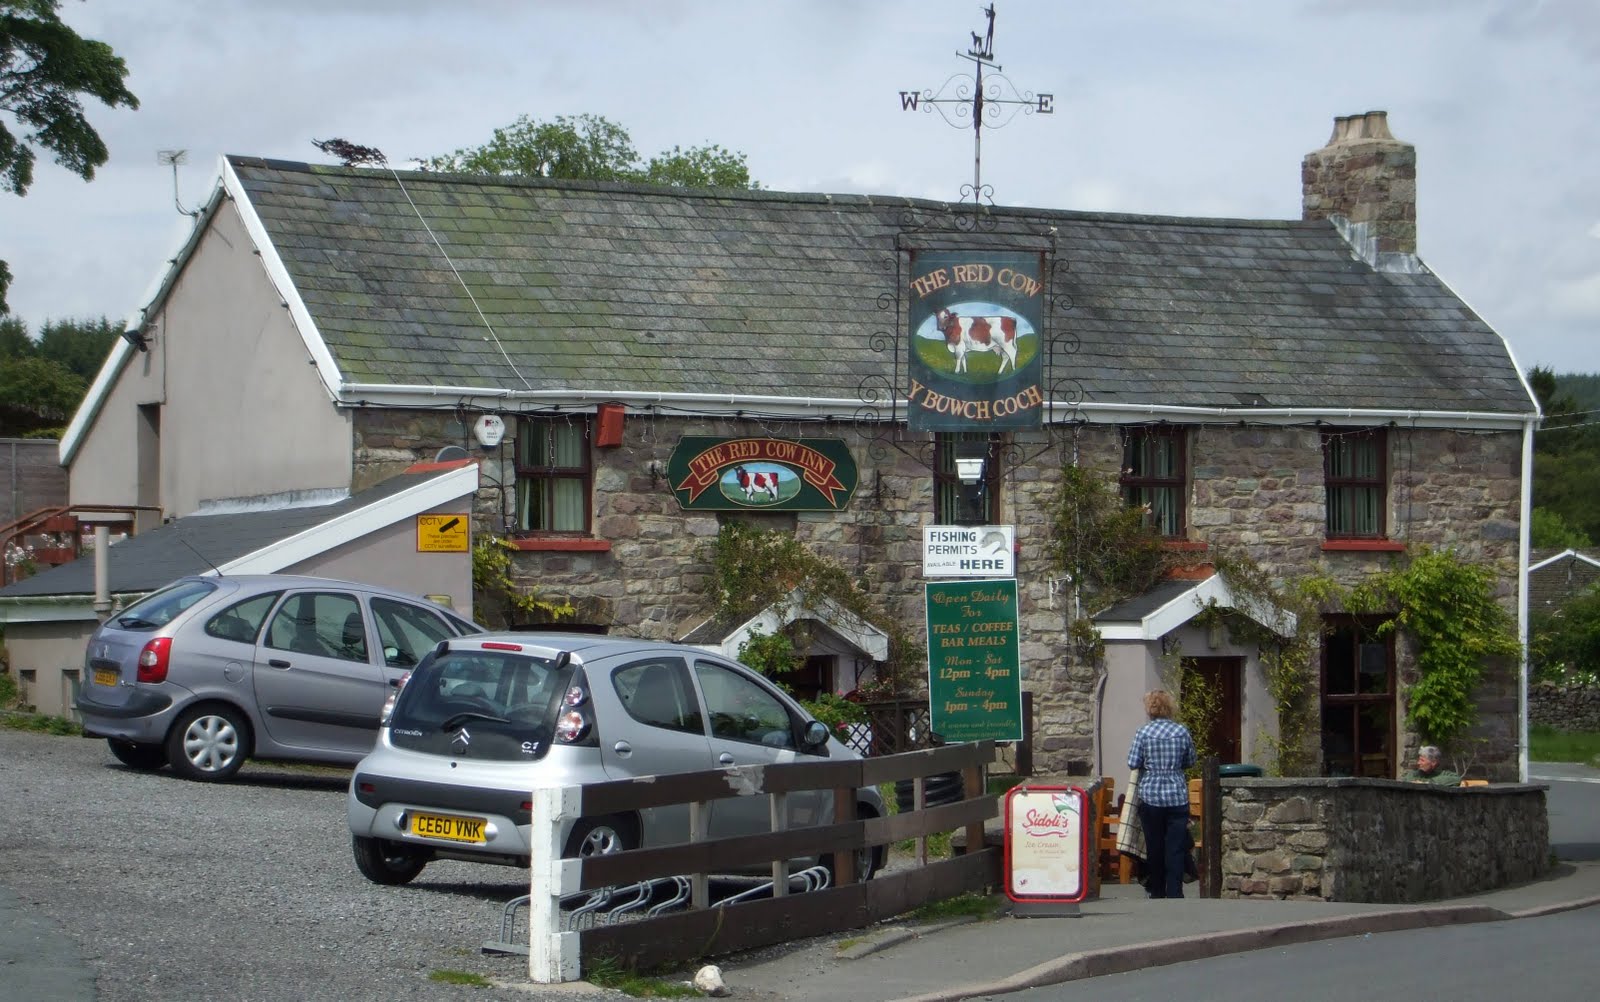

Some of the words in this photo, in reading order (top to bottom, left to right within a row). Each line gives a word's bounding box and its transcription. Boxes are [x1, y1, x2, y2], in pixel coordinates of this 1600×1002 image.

[899, 91, 920, 111] W
[1036, 93, 1053, 114] E
[910, 268, 950, 298] THE
[952, 264, 994, 283] RED
[997, 268, 1042, 297] COW
[907, 378, 925, 400] Y
[921, 389, 991, 419] BUWCH
[992, 384, 1043, 417] COCH
[695, 447, 726, 473] THE
[729, 441, 760, 459] RED
[765, 442, 798, 460] COW
[799, 449, 828, 474] INN
[420, 518, 442, 526] CCTV
[930, 531, 976, 542] FISHING
[928, 545, 978, 555] PERMITS
[960, 559, 1004, 570] HERE
[932, 591, 967, 606] Open
[971, 589, 1009, 604] Daily
[961, 605, 982, 617] For
[932, 624, 960, 634] TEAS
[971, 622, 1014, 632] COFFEE
[941, 638, 964, 647] BAR
[967, 636, 1007, 646] MEALS
[944, 655, 972, 666] Mon
[984, 653, 1003, 664] Sat
[939, 667, 971, 681] 12pm
[984, 666, 1010, 680] 4pm
[955, 687, 994, 700] Sunday
[944, 701, 968, 714] 1pm
[982, 700, 1008, 712] 4pm
[521, 741, 540, 750] C1
[1022, 808, 1069, 829] Sidoli's
[418, 816, 451, 835] CE60
[456, 820, 482, 838] VNK
